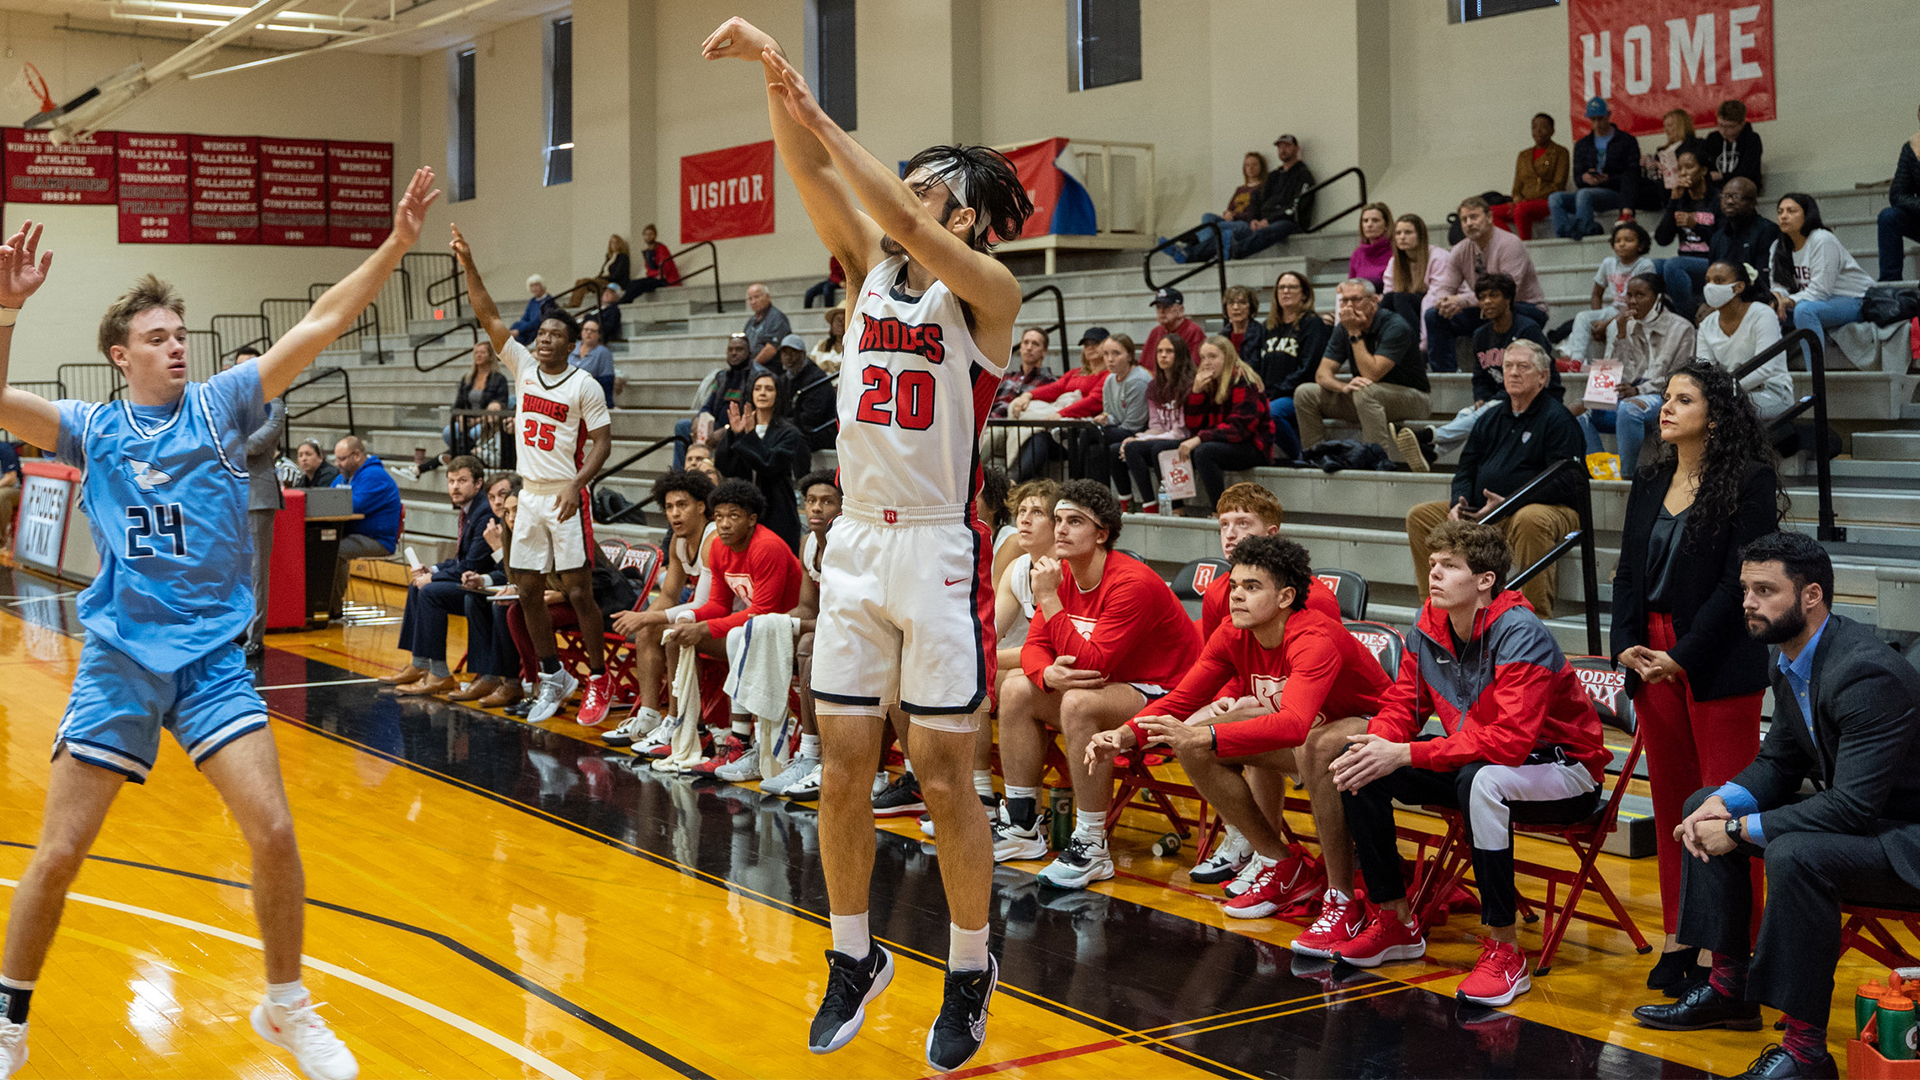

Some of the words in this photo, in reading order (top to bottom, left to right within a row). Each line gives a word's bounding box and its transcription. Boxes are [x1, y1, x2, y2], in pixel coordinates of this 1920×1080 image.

[1579, 4, 1763, 102] HOME
[118, 148, 188, 161] VOLLEYBALL
[261, 144, 325, 157] VOLLEYBALL
[328, 147, 392, 160] VOLLEYBALL
[35, 154, 87, 166] ATHLETIC
[191, 152, 258, 165] VOLLEYBALL
[26, 165, 95, 177] CONFERENCE
[137, 162, 170, 172] NCAA
[198, 165, 252, 176] SOUTHERN
[12, 175, 109, 191] CHAMPIONS
[119, 172, 188, 184] TOURNAMENT
[194, 177, 256, 189] COLLEGIATE
[201, 190, 250, 201] ATHLETIC
[270, 185, 318, 197] ATHLETIC
[338, 188, 385, 199] ATHLETIC
[689, 173, 764, 212] VISITOR
[193, 201, 258, 213] CONFERENCE
[262, 198, 325, 210] CONFERENCE
[330, 200, 391, 213] CONFERENCE
[856, 364, 936, 431] 20
[522, 393, 569, 423] RHODES
[523, 419, 556, 452] 25
[28, 484, 65, 520] RHODES
[125, 502, 188, 559] 24
[25, 518, 54, 557] LYNX
